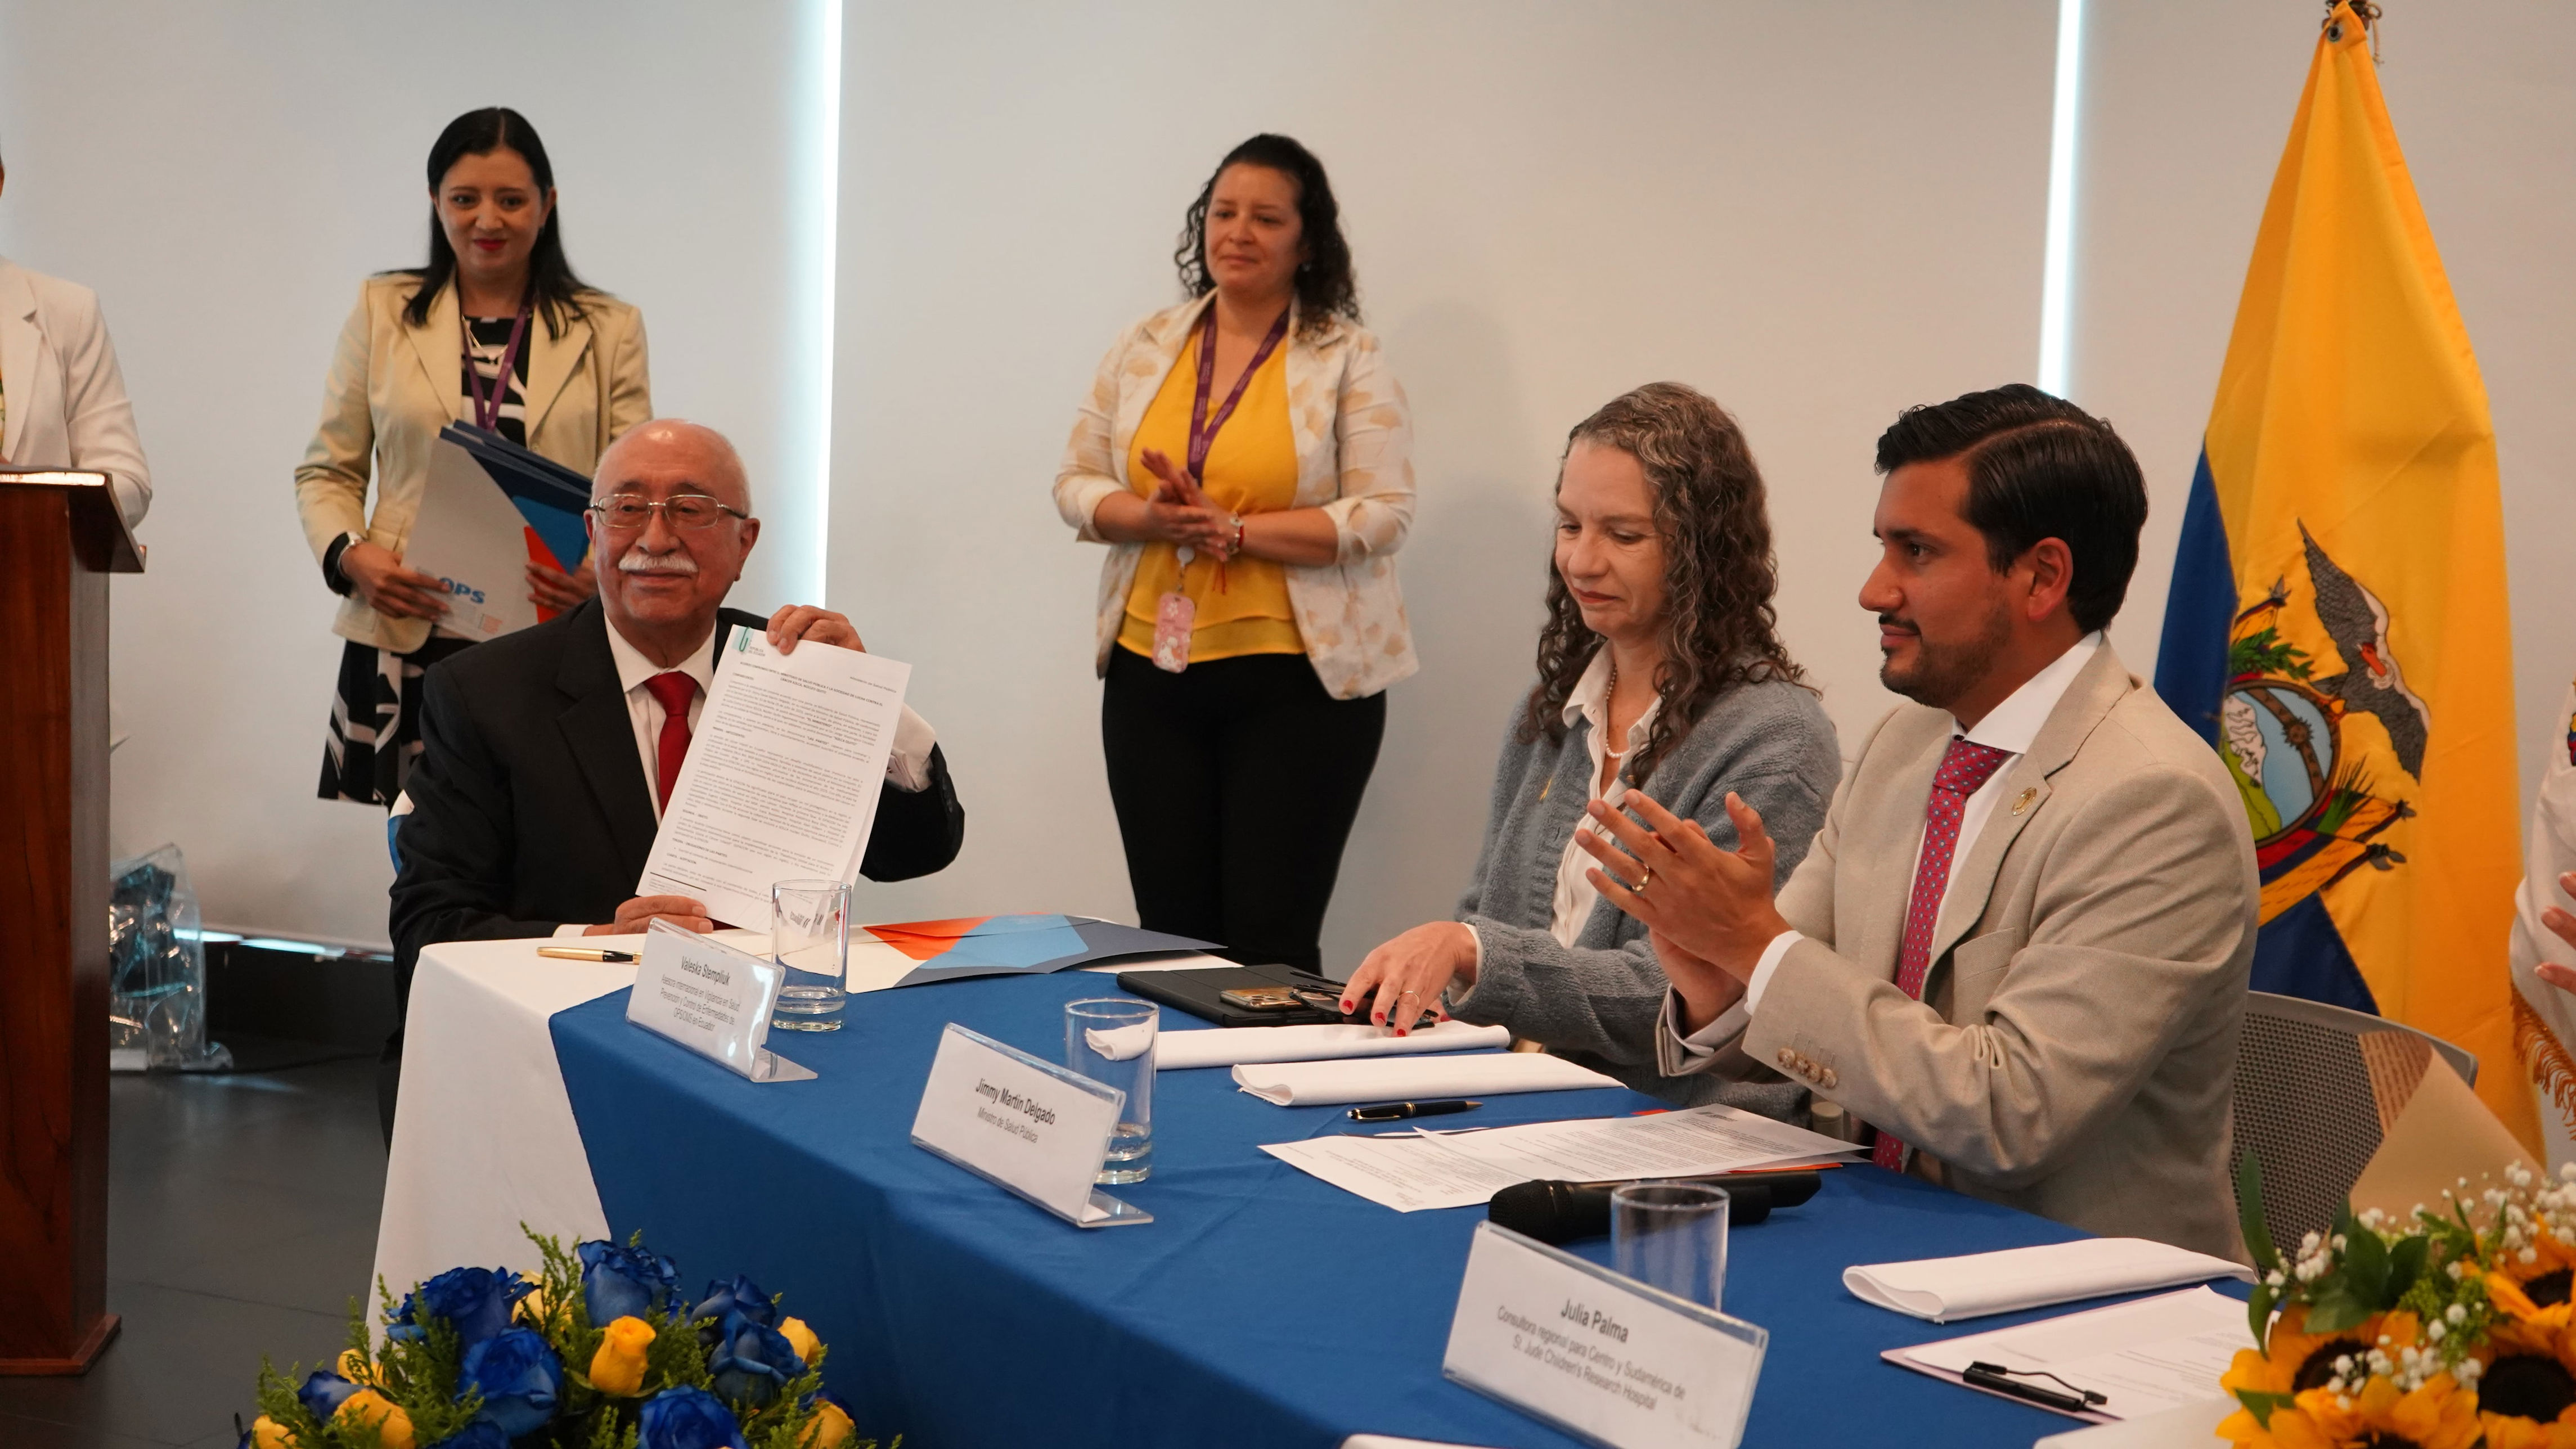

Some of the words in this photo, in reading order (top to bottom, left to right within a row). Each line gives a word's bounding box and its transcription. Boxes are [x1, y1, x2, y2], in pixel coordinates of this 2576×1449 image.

[681, 956, 702, 975] Valeska
[698, 1016, 716, 1032] Ecuador
[975, 1078, 1000, 1104] Jimmy
[1024, 1098, 1055, 1125] Delgado
[977, 1106, 997, 1125] Ministro
[997, 1116, 1004, 1128] de
[1004, 1118, 1019, 1135] Salud
[1561, 1298, 1589, 1326] Julia
[1591, 1310, 1629, 1343] Palma
[1498, 1305, 1537, 1335] Consultora
[1538, 1326, 1568, 1348] regional
[1568, 1340, 1588, 1358] para
[1588, 1346, 1615, 1370] Centro
[1615, 1361, 1623, 1376] y
[1674, 1383, 1687, 1400] de
[1523, 1340, 1543, 1361] Jude
[1583, 1365, 1622, 1394] Research
[1622, 1383, 1658, 1411] Hospital
